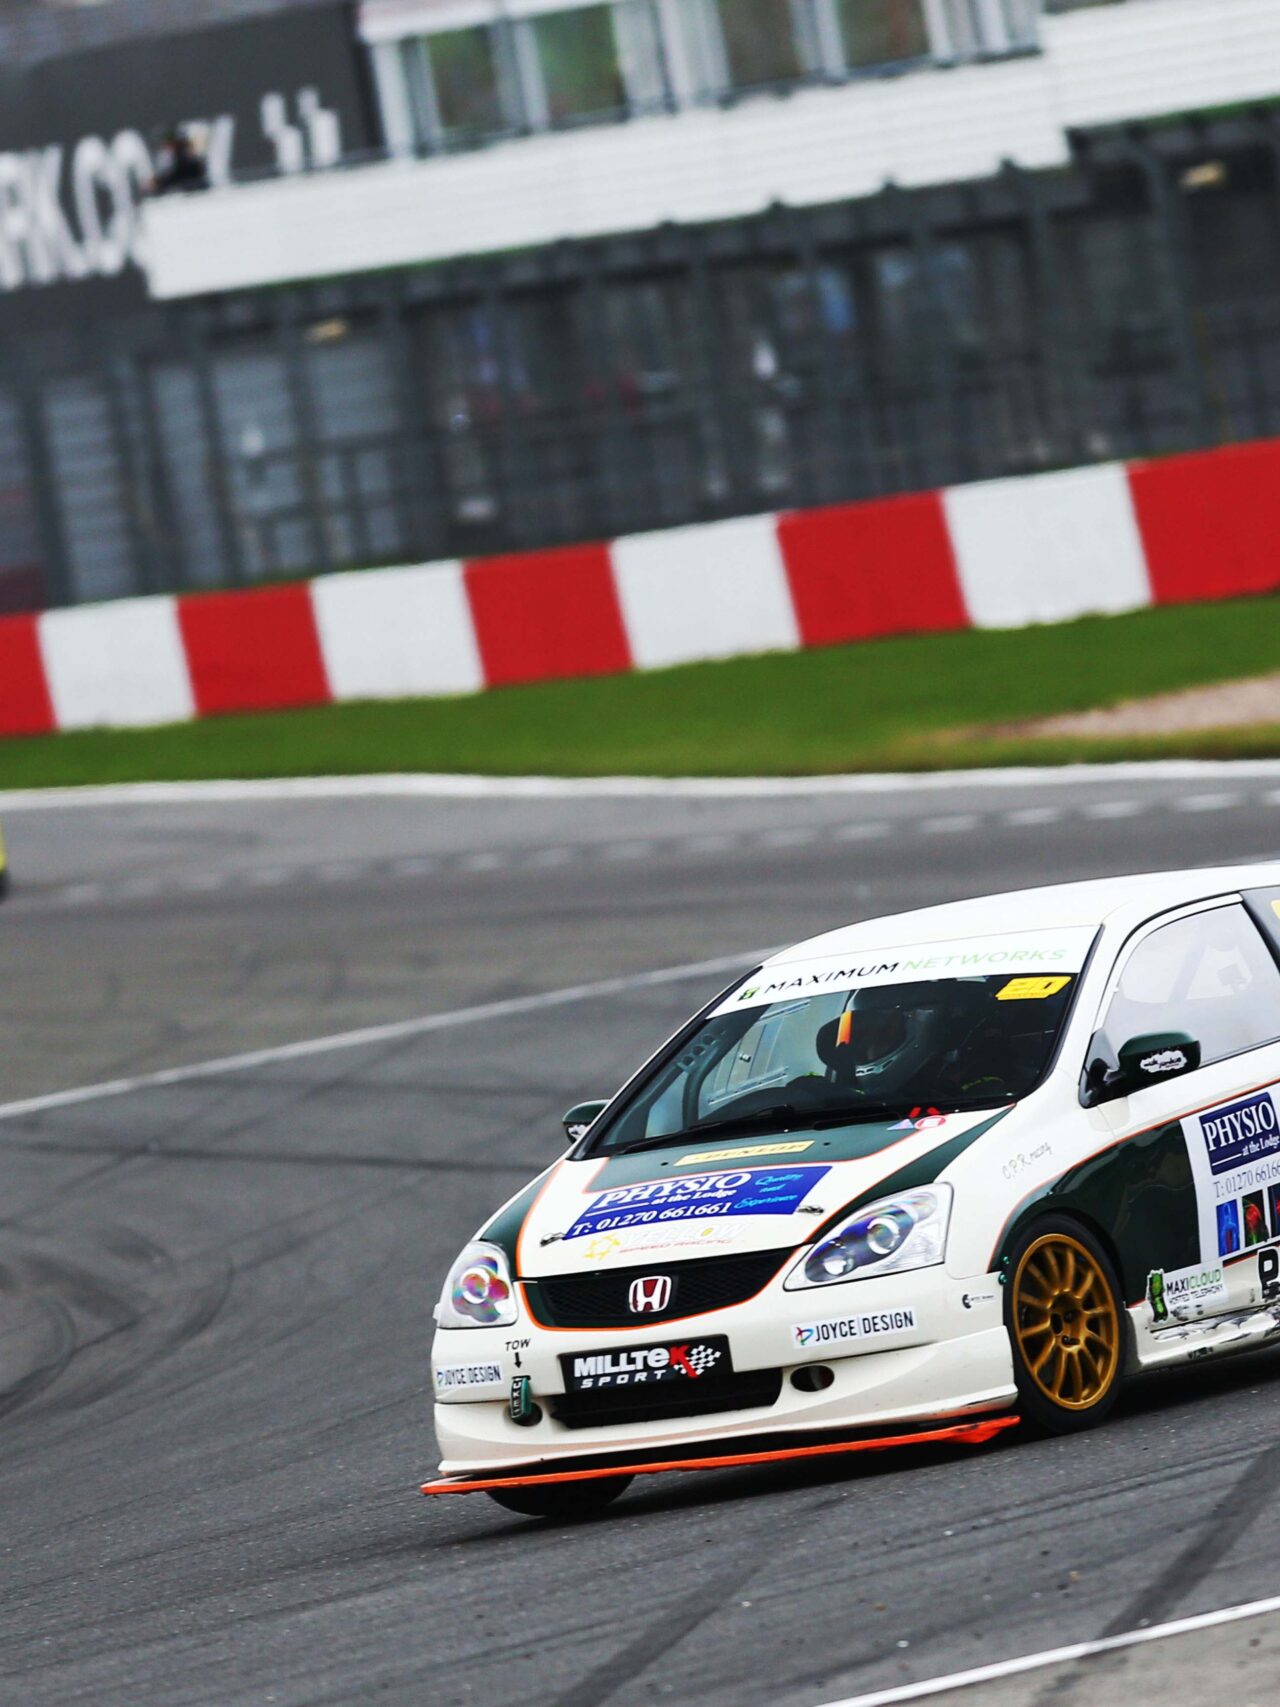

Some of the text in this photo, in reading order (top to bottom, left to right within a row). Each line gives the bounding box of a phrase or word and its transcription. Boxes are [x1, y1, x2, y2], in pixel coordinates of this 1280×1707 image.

[764, 949, 1069, 994] MAXIMUM NETWORKS
[1203, 1101, 1275, 1151] PHYSIO
[1242, 1133, 1280, 1156] at the Lodge
[592, 1172, 752, 1209] PHYSIO
[651, 1188, 737, 1206] at the Lodge
[1213, 1180, 1225, 1198] T:
[1226, 1169, 1254, 1194] 01270
[571, 1202, 732, 1238] T: 01270 661661
[1166, 1269, 1223, 1296] MAXICLOUD
[815, 1310, 914, 1342] JOYCE DESIGN
[505, 1338, 531, 1352] TOW
[468, 1365, 502, 1384] DESIGN
[581, 1369, 669, 1390] SPORT
